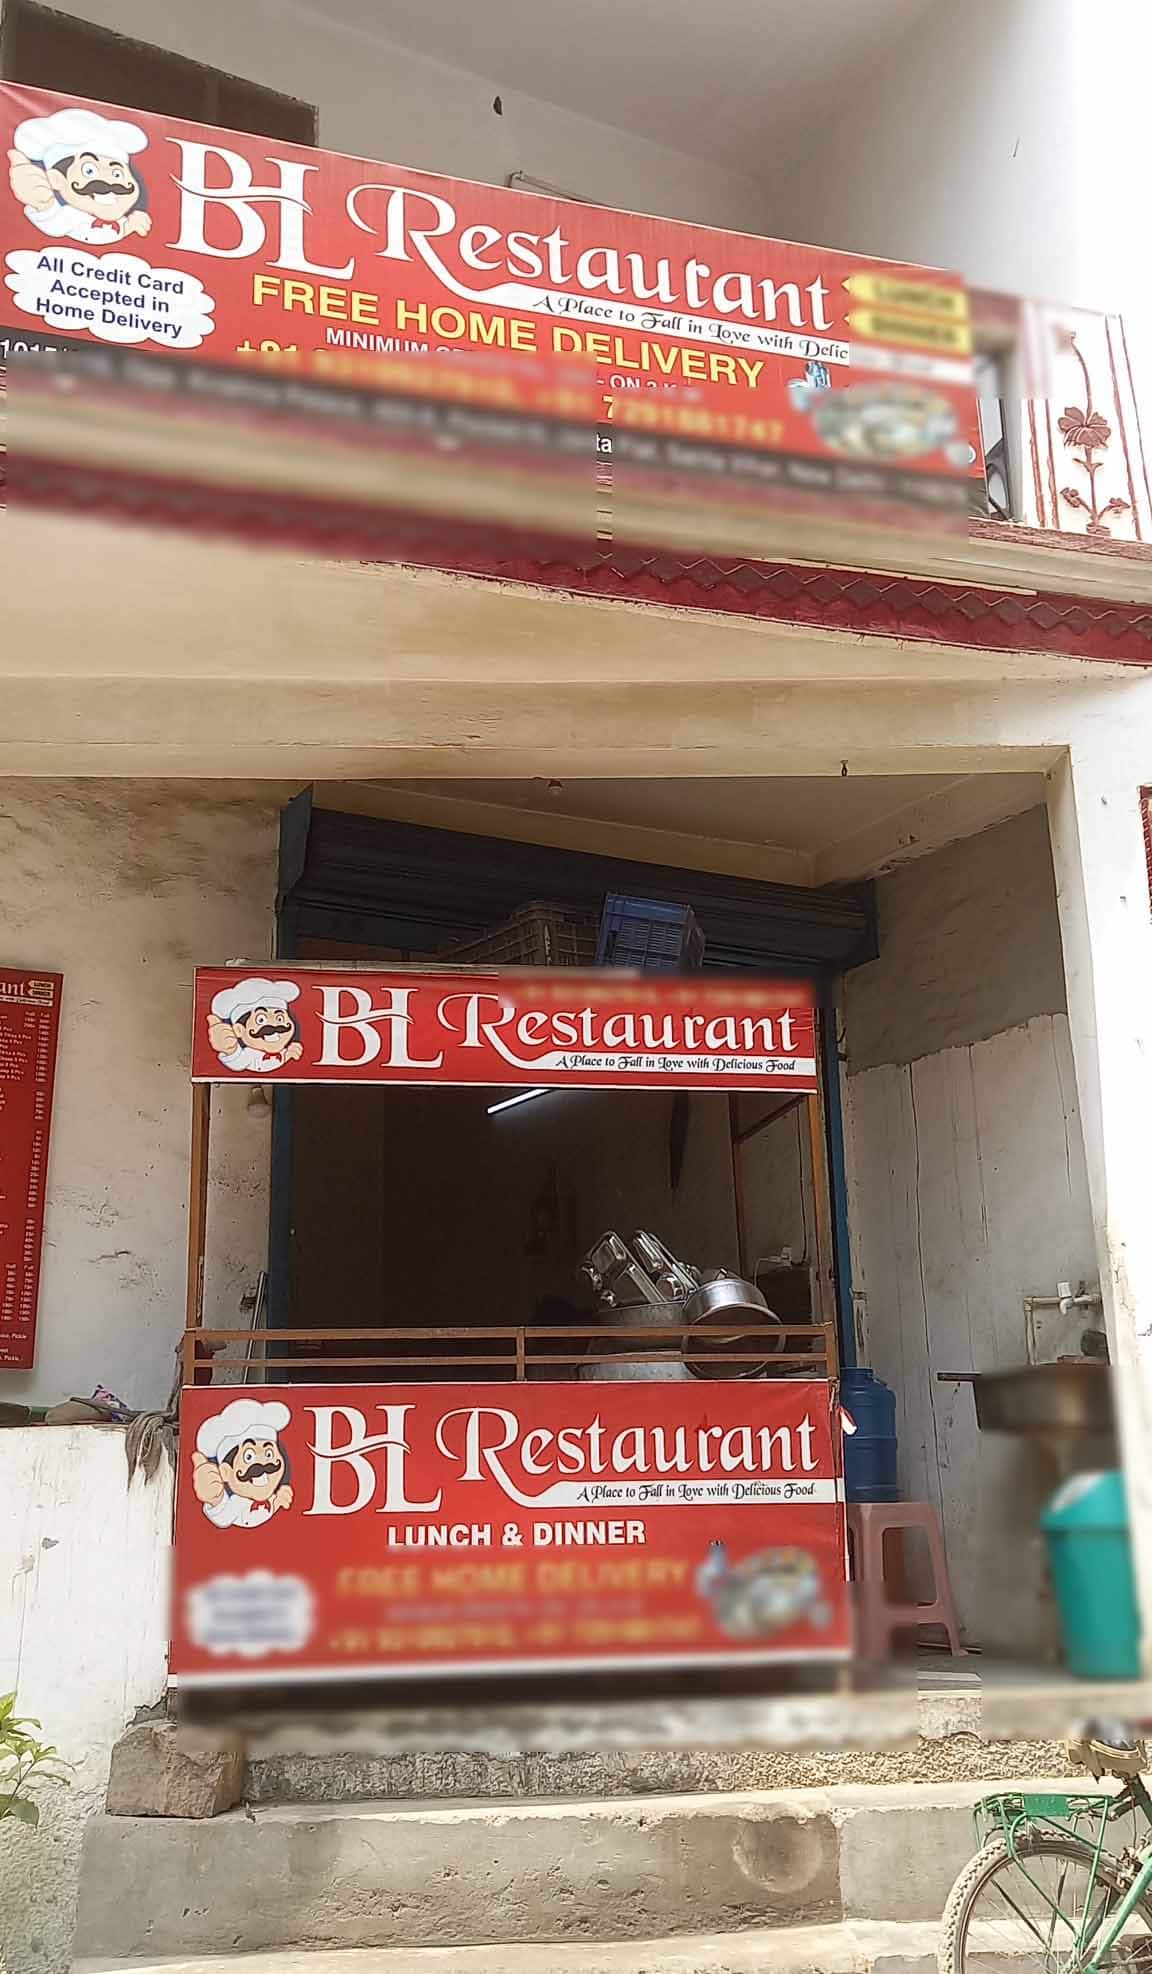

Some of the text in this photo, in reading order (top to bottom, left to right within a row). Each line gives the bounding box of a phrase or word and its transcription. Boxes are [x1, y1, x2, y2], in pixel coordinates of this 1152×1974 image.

[165, 136, 833, 331] BL Restaurant
[37, 255, 184, 295] All Credit Card
[51, 280, 169, 313] Accepted in
[36, 297, 182, 338] Home Delivery
[253, 273, 380, 326] FREE
[396, 299, 537, 351] HOME
[552, 326, 765, 388] DELIVERY
[533, 296, 554, 313] A
[557, 296, 613, 318] Place
[619, 310, 635, 322] to
[641, 311, 682, 330] Fall
[688, 319, 703, 334] in
[709, 322, 750, 344] Love
[757, 335, 793, 350] with
[312, 984, 800, 1069] BL Restaurant
[555, 1056, 796, 1072] A Place to Fall in Love with Delicious Food
[302, 1404, 819, 1517] BL Restaurant
[577, 1482, 815, 1502] A Place to Fall in Love with Delicious Food
[387, 1520, 646, 1546] LUNCH & DINNER
